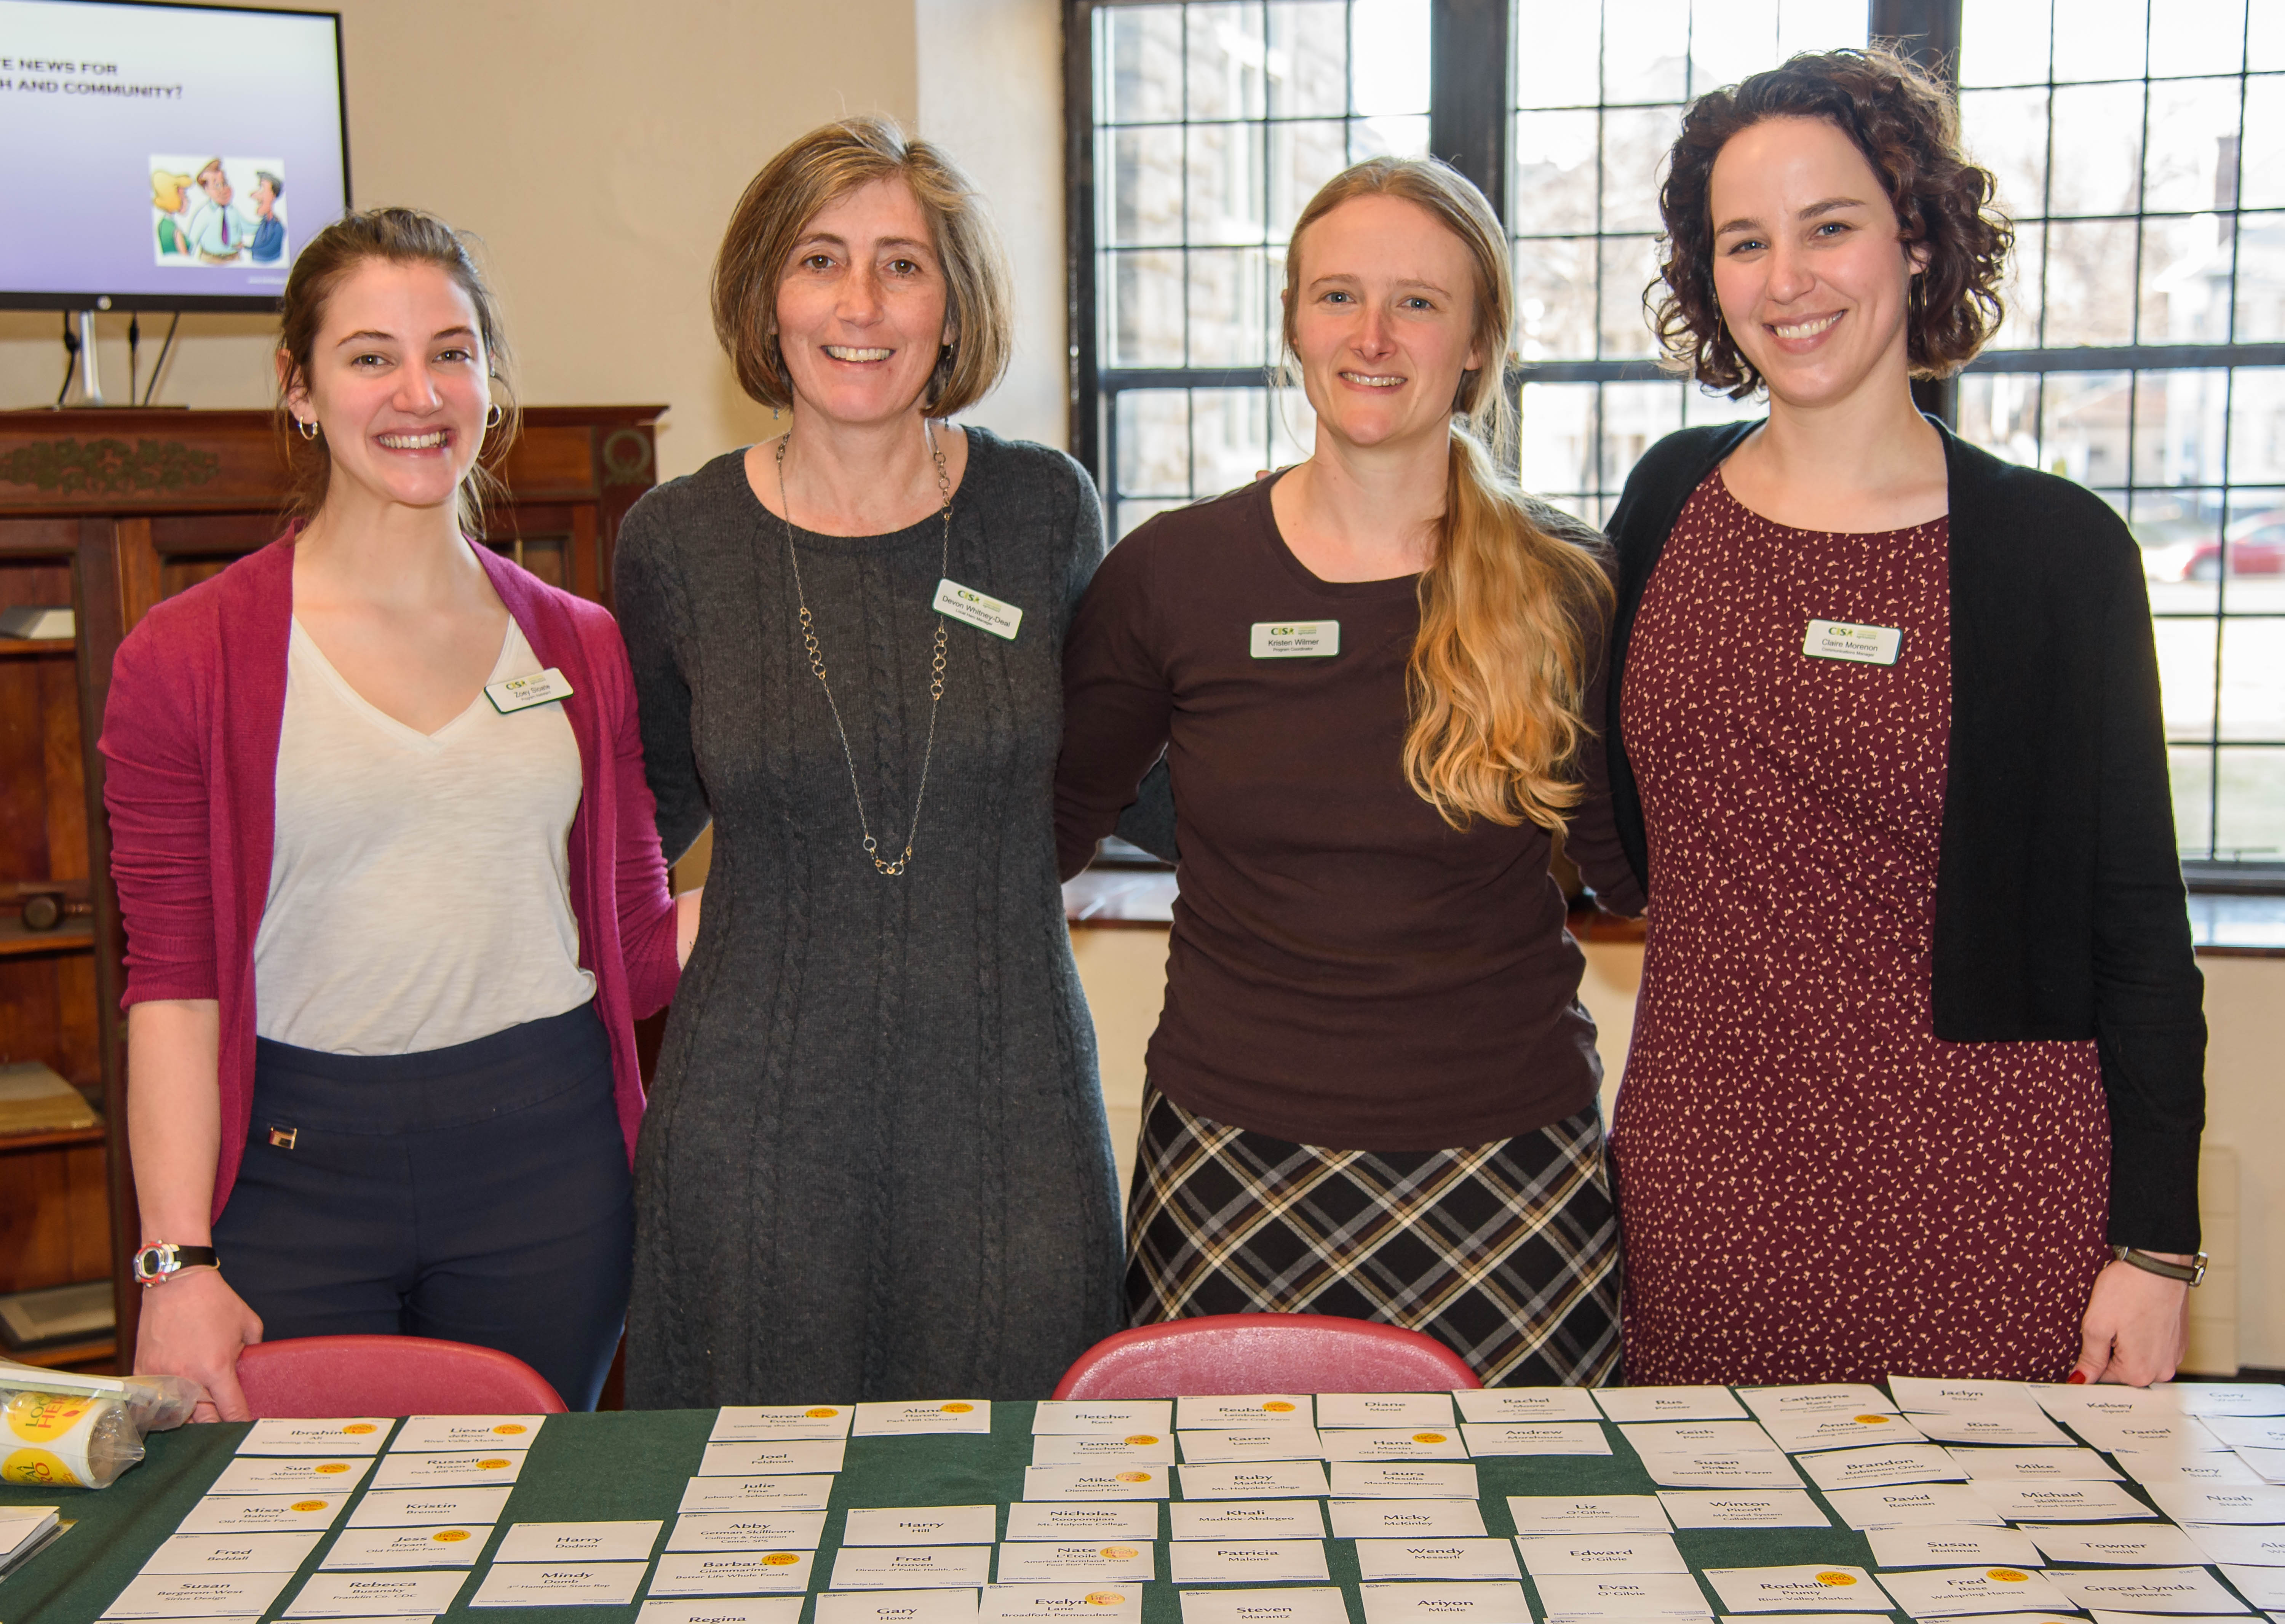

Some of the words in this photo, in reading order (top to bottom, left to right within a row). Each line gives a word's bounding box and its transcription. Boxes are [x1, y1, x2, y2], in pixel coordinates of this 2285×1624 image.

[19, 59, 75, 74] NEWS
[81, 62, 118, 76] FOR
[19, 80, 58, 93] AND
[64, 82, 182, 99] COMMUNITY?
[958, 590, 981, 604] CISA
[943, 596, 964, 609] Devon
[966, 605, 1011, 627] Whitney-Deal
[1828, 627, 1853, 637] CISA
[1822, 639, 1843, 647] Claire
[1845, 642, 1878, 651] Morenon
[1846, 1460, 1915, 1470] Brandon
